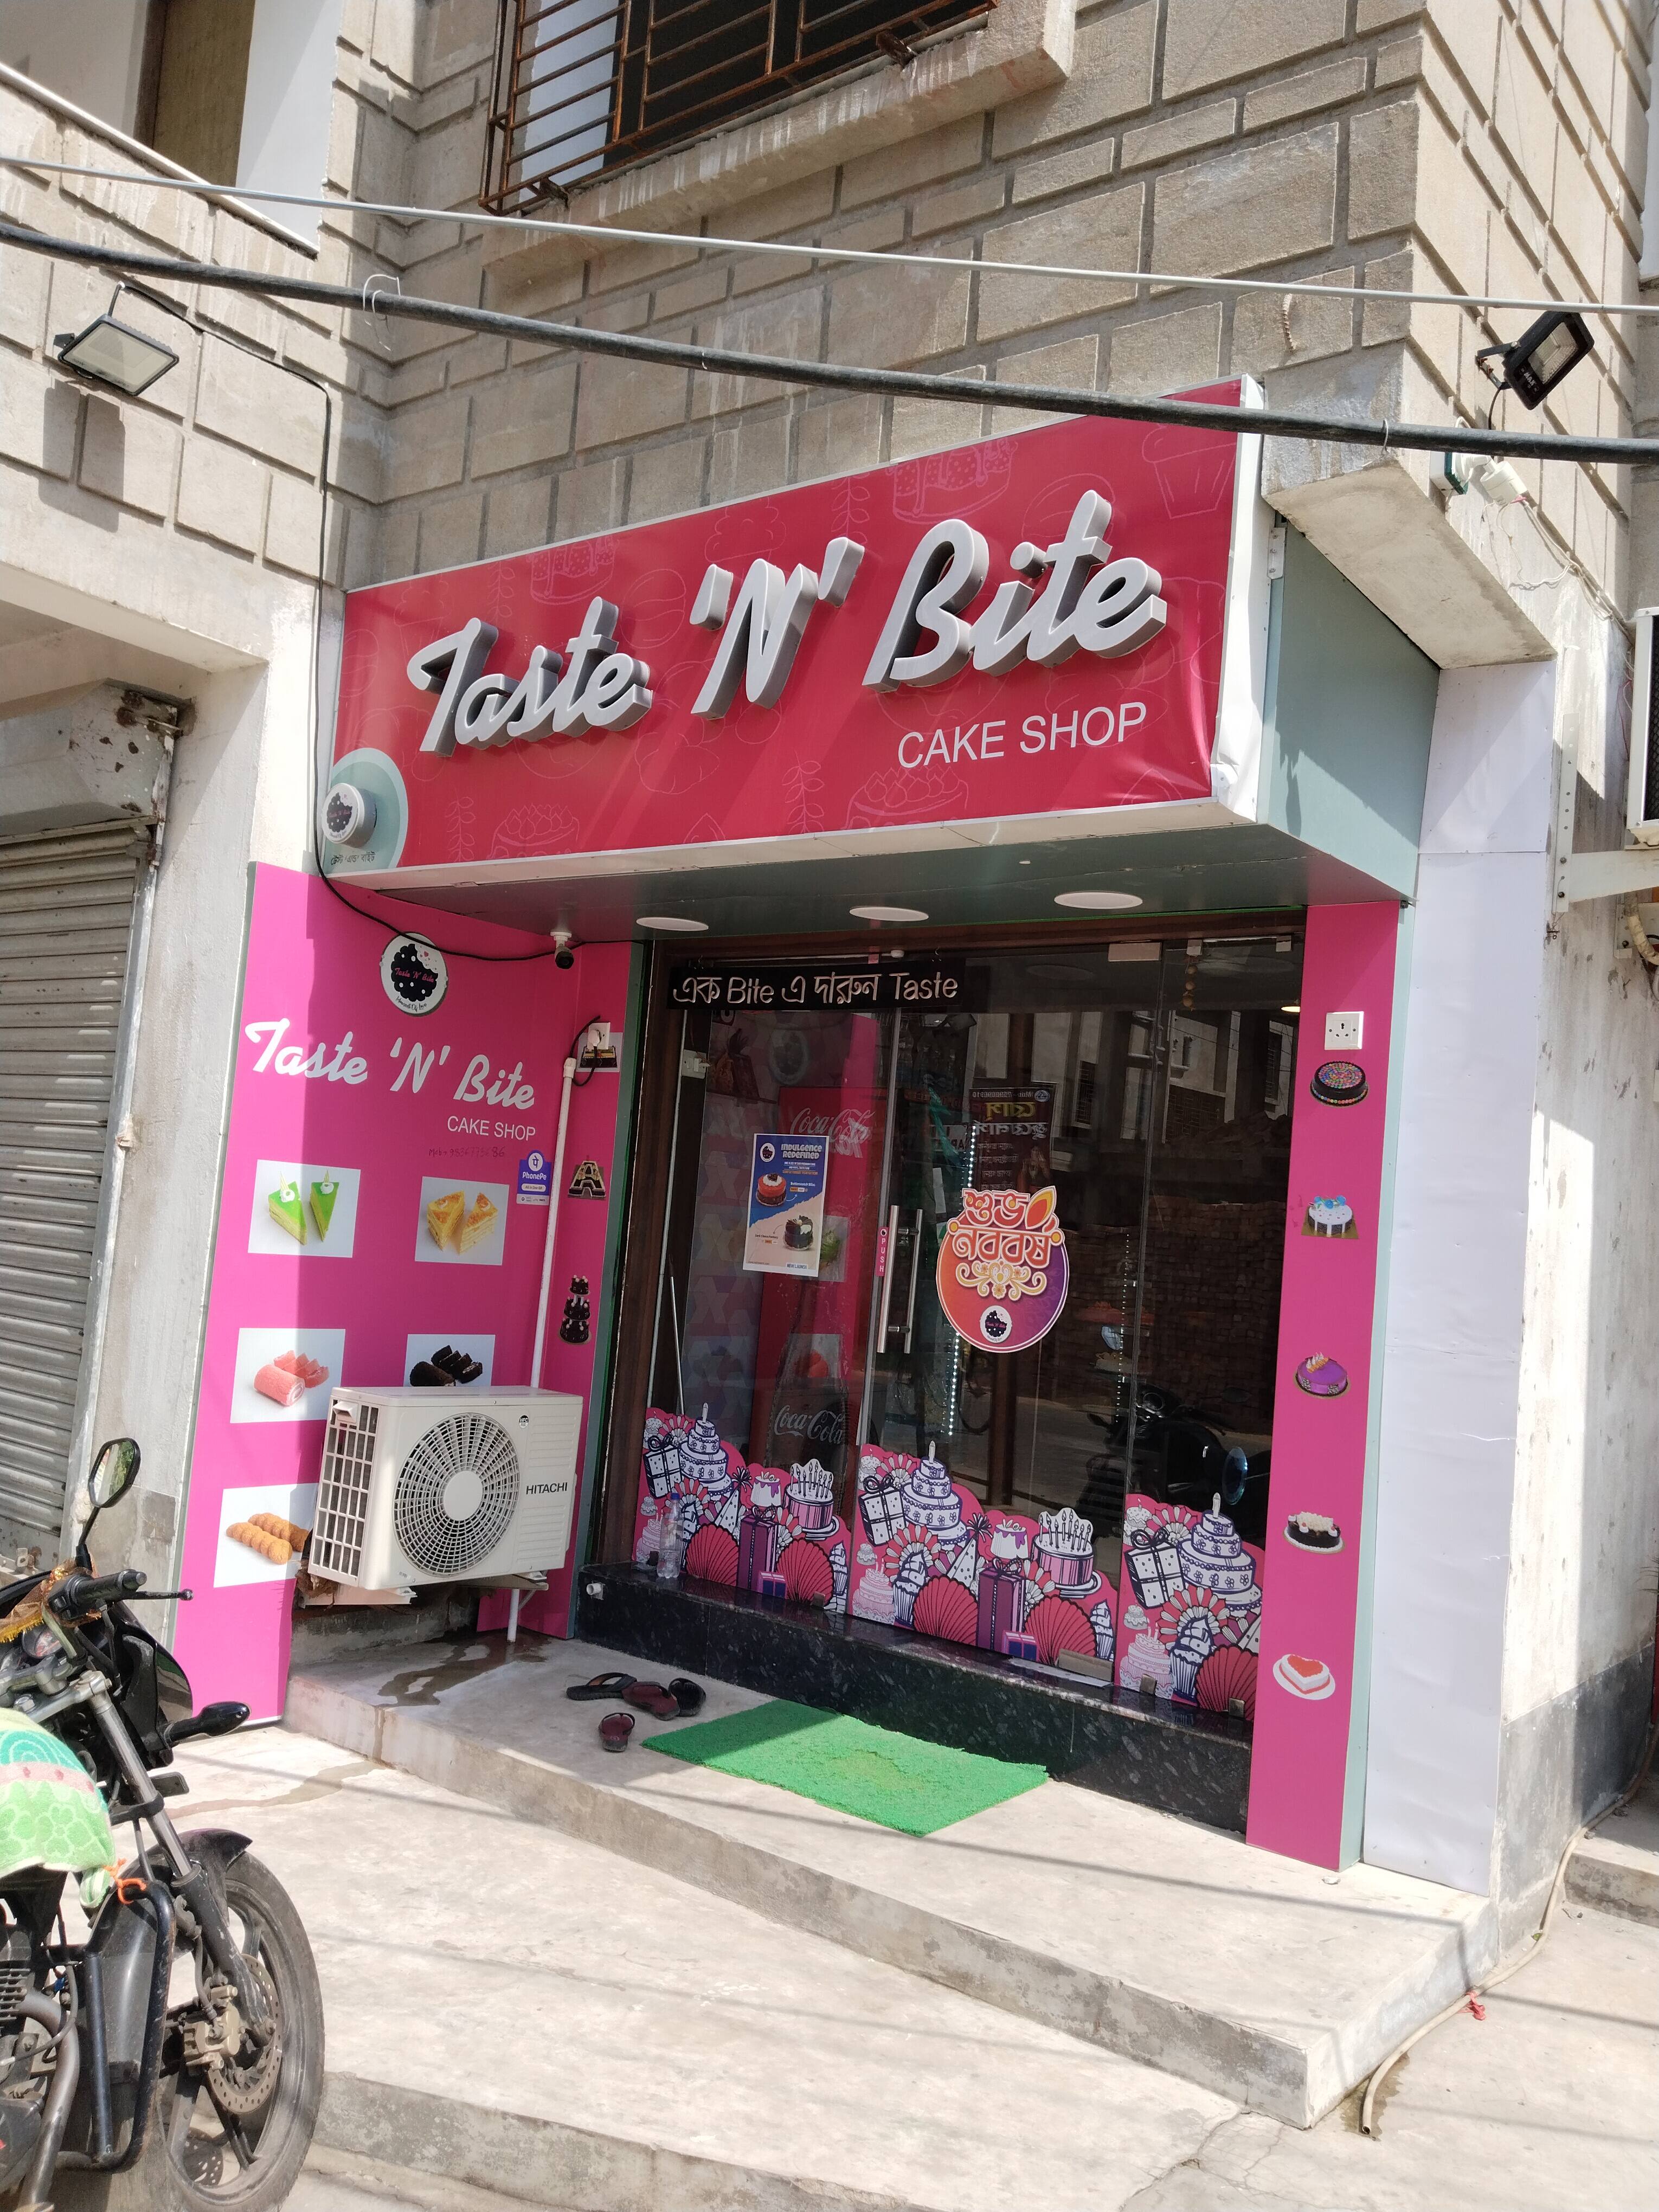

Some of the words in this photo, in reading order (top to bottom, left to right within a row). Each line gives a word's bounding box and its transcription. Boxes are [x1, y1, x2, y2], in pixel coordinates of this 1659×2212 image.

[407, 596, 653, 757] Taste
[863, 490, 1167, 692] Bite
[898, 720, 1006, 768] CAKE
[1020, 702, 1146, 754] SHOP
[395, 967, 410, 978] Taste
[673, 976, 723, 1004] এক
[727, 976, 774, 1004] Bite
[782, 975, 806, 1004] এ
[890, 972, 958, 1000] Taste
[245, 1019, 368, 1084] Taste
[454, 1054, 535, 1110] Bite
[447, 1116, 490, 1136] CAKE
[494, 1122, 536, 1141] SHOP
[522, 1172, 546, 1180] PhonePe
[964, 1190, 1028, 1227] শুভ
[952, 1218, 1056, 1268] নববর্ষ
[774, 1405, 843, 1444] Coca-Cola
[526, 1482, 568, 1495] HITACHI
